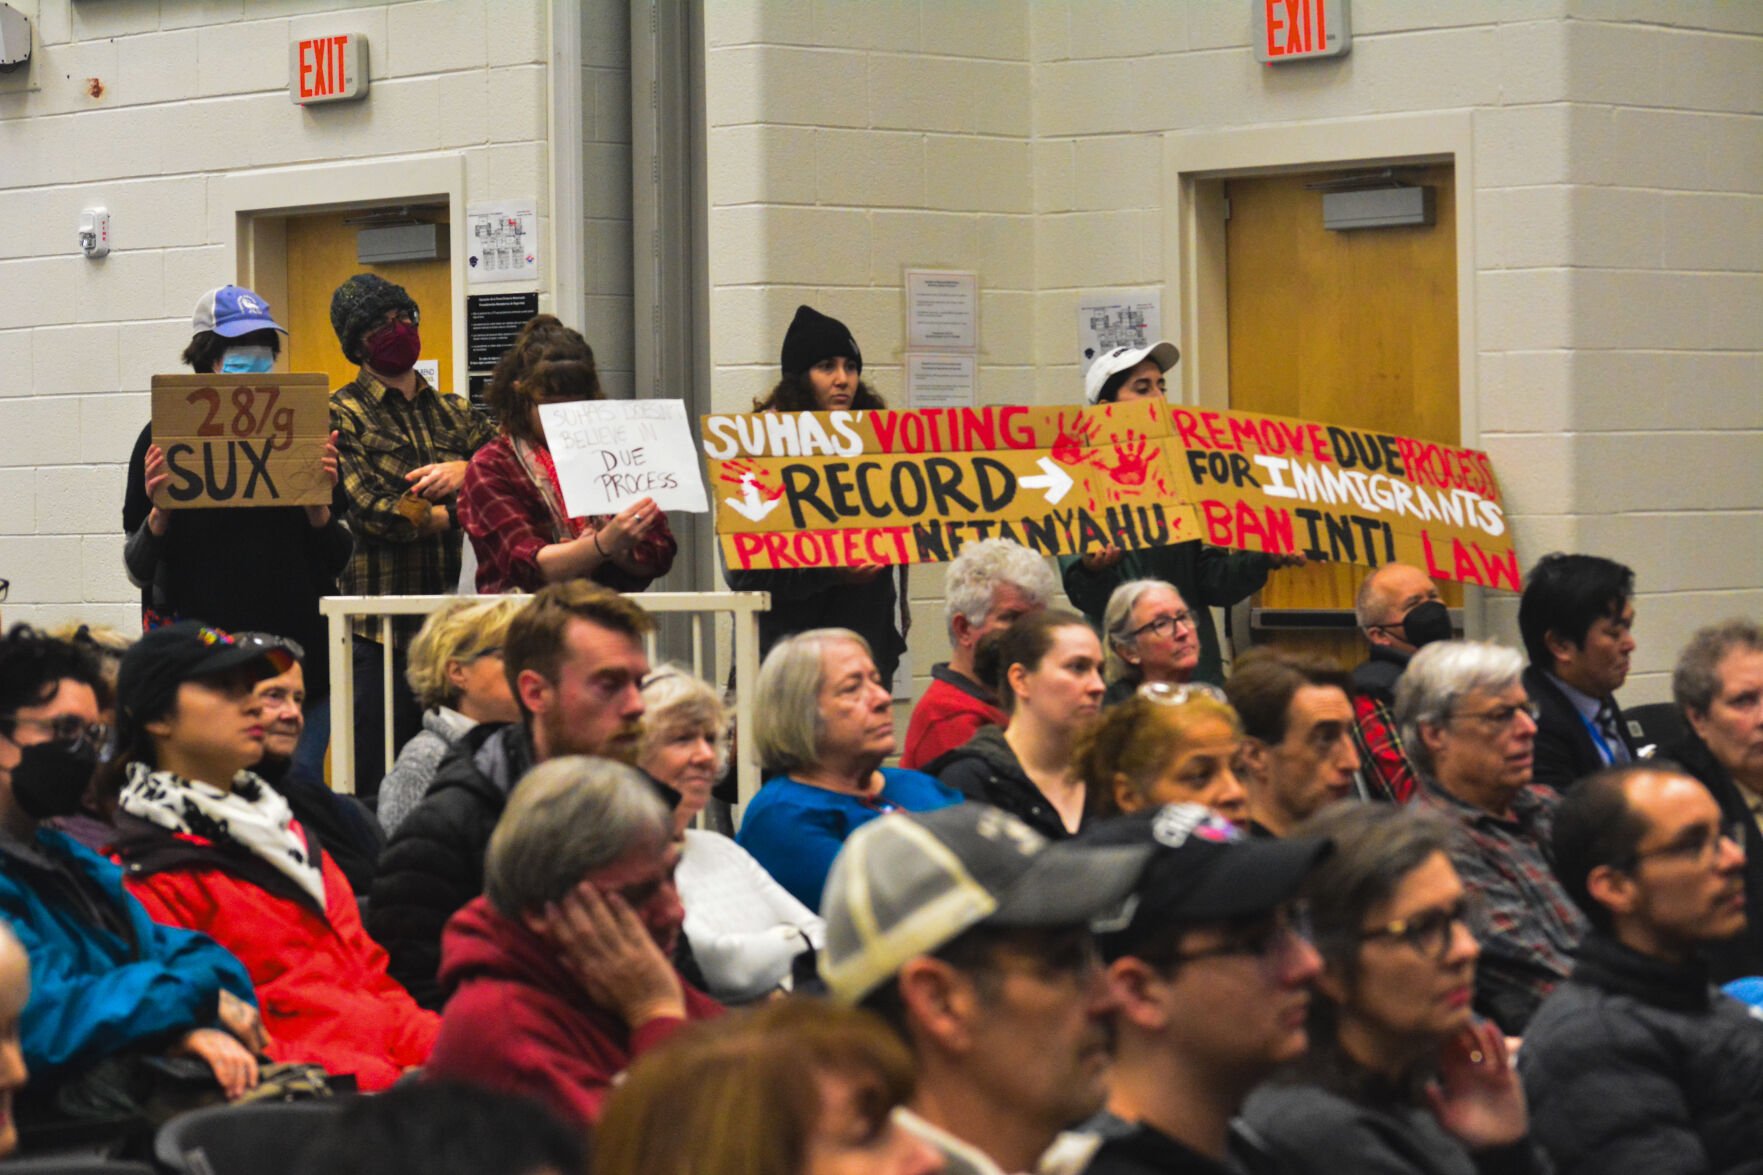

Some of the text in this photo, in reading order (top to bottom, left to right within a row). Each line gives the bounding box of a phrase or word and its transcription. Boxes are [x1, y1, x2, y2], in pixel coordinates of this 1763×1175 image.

[1265, 0, 1326, 56] EXIT
[299, 35, 348, 98] EXIT
[186, 384, 295, 450] 287g
[703, 406, 1036, 460] SUHAS' VOTING
[166, 437, 280, 501] SUX
[593, 470, 679, 503] PROCESS
[594, 447, 646, 472] DUE
[1171, 408, 1499, 501] REMOVE DUE PROCESS
[781, 456, 1017, 529] RECORD
[1185, 449, 1505, 537] FOR IMMIGRANTS
[733, 503, 1171, 570] PROTECT NETANYAHU
[1201, 499, 1296, 556] BAN
[1419, 529, 1521, 593] LAW
